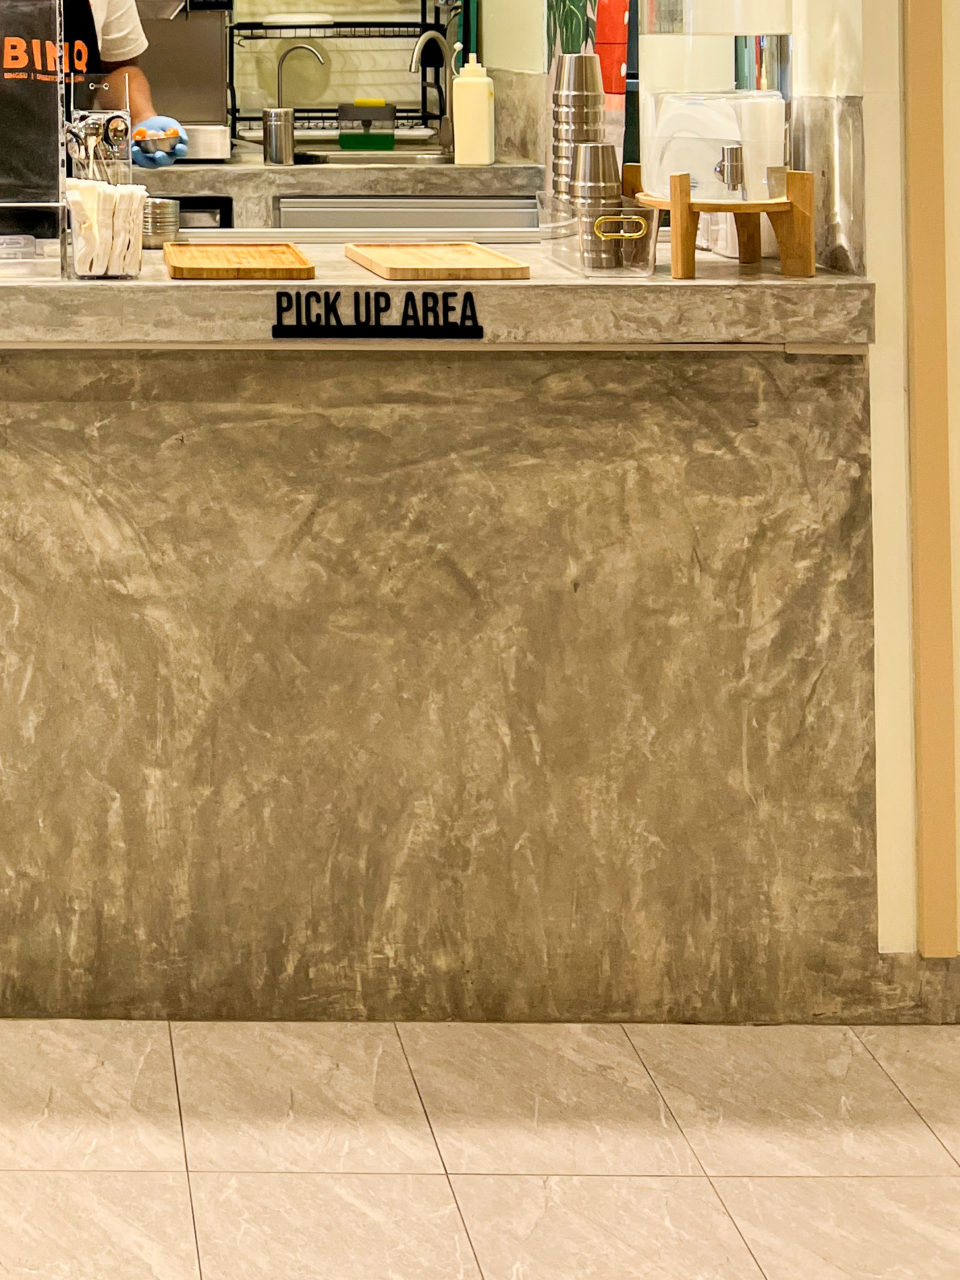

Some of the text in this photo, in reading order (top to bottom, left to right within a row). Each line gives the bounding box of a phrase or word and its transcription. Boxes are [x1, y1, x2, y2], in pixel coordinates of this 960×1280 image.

[3, 37, 88, 73] BINQ
[276, 291, 478, 326] PICK UP AREA
